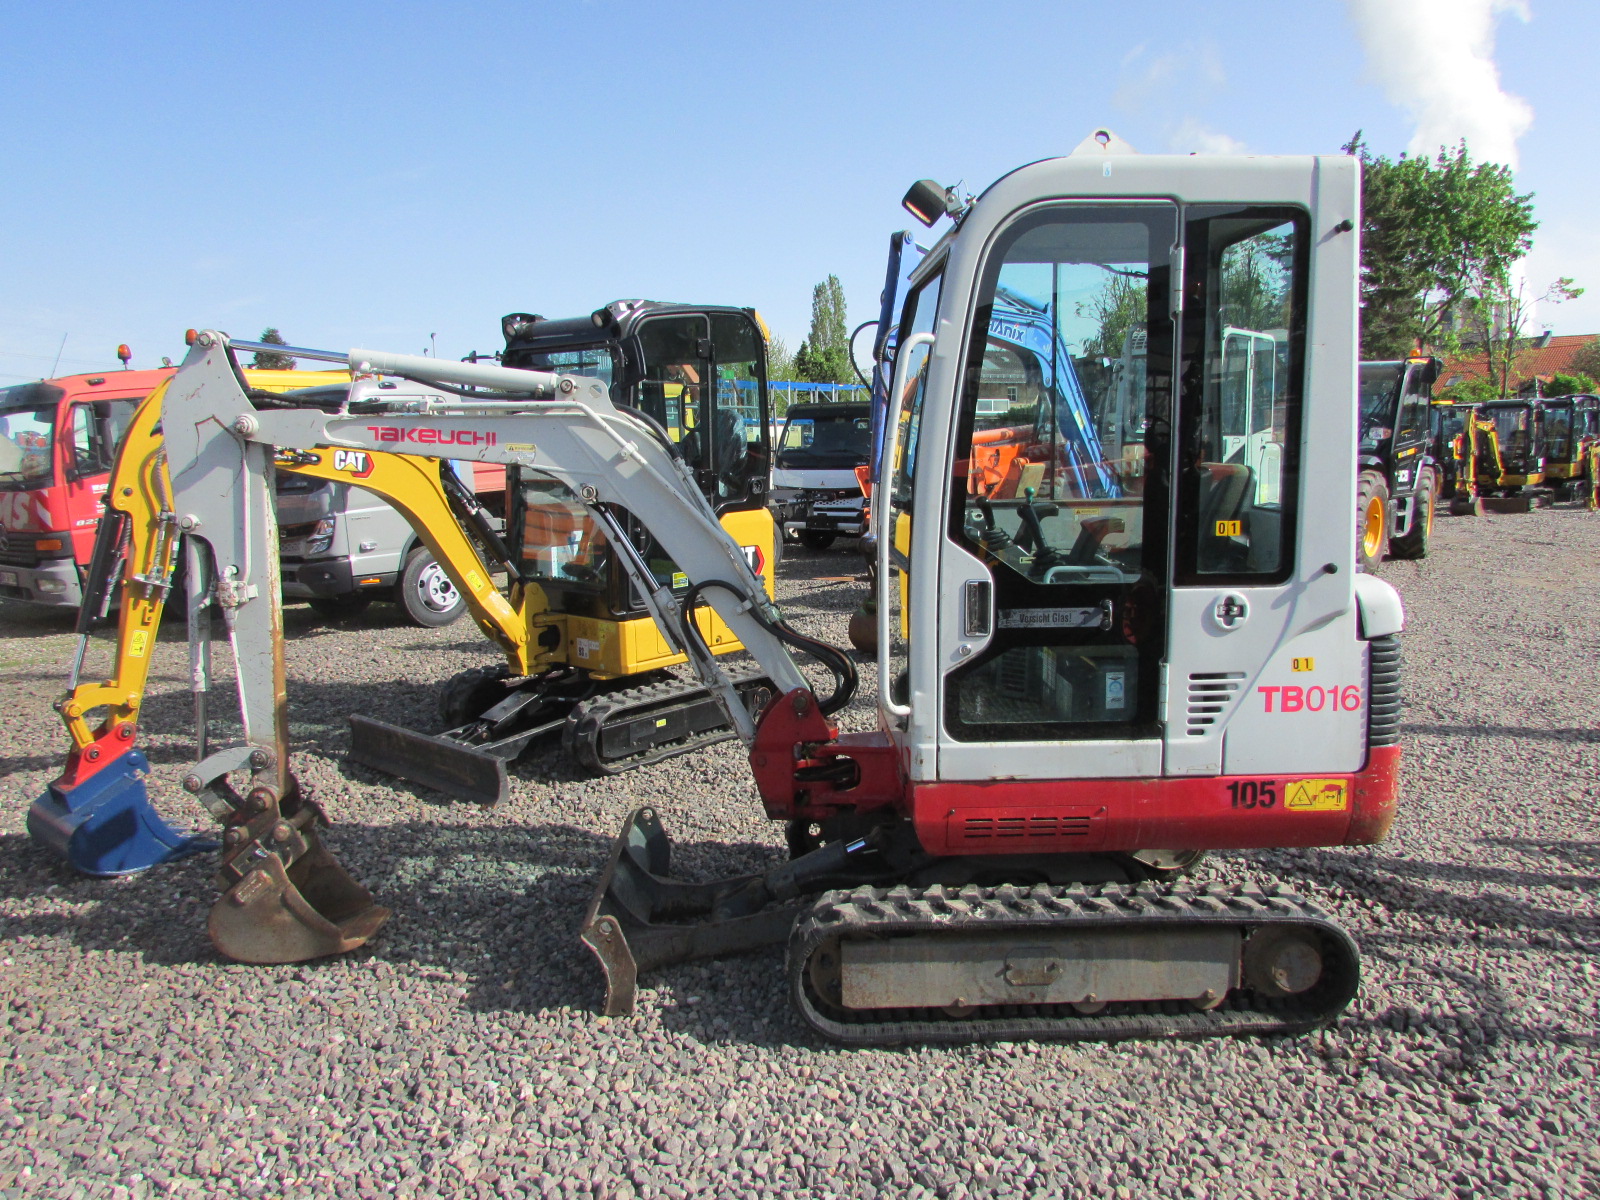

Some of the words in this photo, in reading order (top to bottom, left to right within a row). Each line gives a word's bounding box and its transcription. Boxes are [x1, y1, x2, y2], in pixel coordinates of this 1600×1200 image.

[367, 426, 497, 446] TAKEUCHI
[334, 450, 366, 472] CAT
[1019, 613, 1050, 623] Vorsicht
[1052, 612, 1072, 623] Glas!
[1257, 685, 1361, 713] TB016
[1226, 781, 1276, 809] 105
